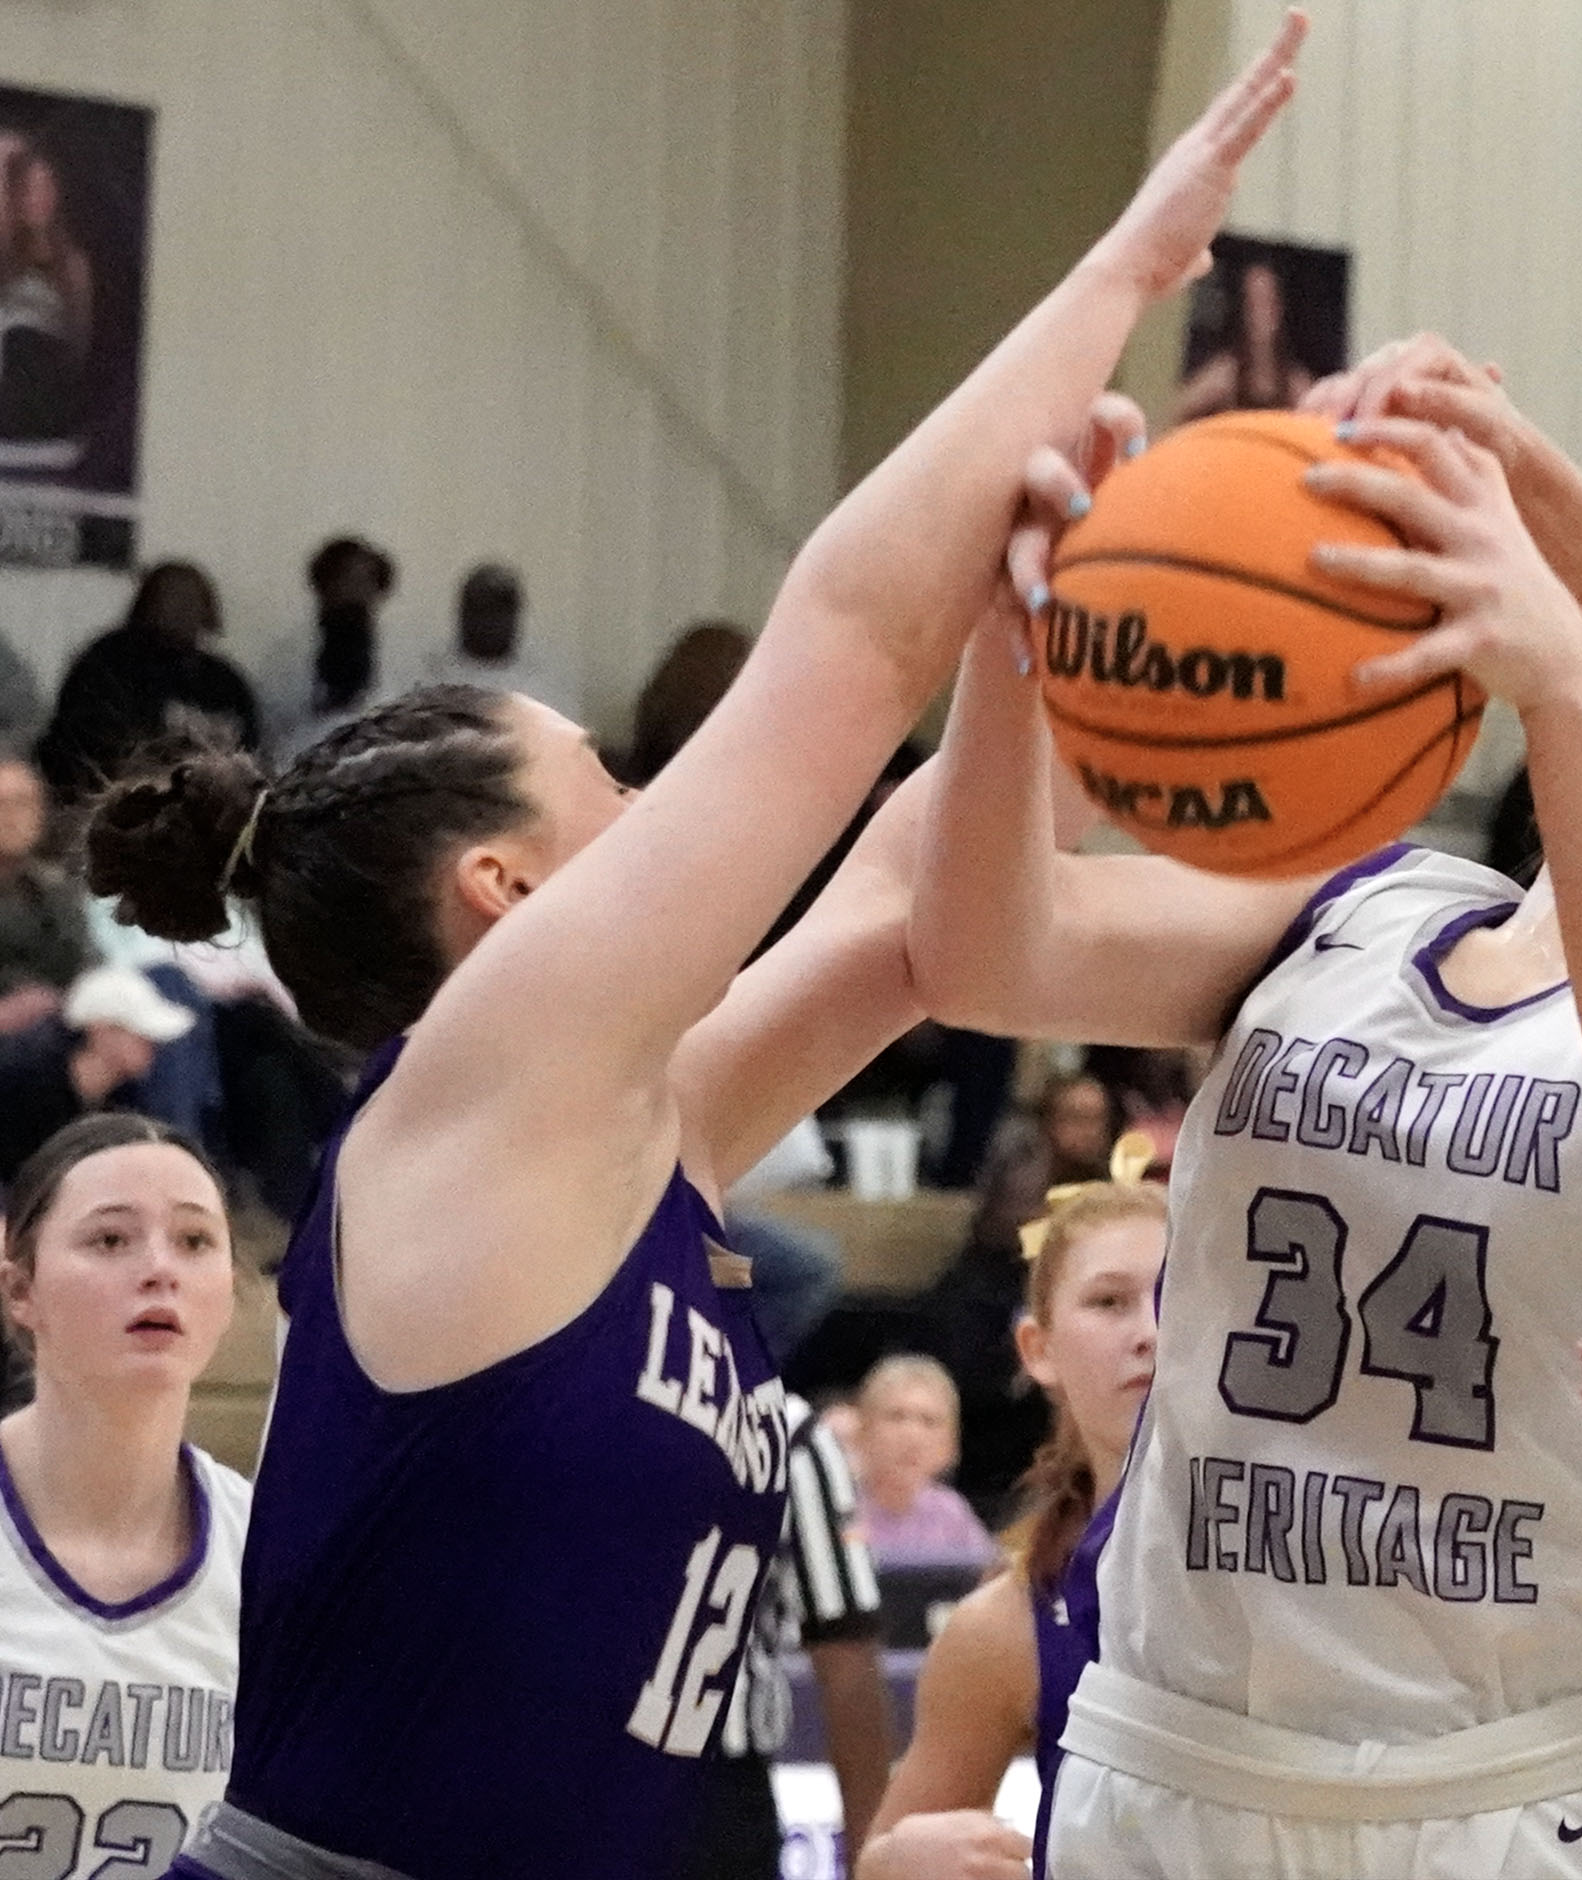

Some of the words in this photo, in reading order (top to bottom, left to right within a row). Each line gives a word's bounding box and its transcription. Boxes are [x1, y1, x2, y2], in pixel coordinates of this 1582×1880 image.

[1046, 603, 1286, 700] Wilson
[1214, 1027, 1582, 1193] DECATUR
[1217, 1186, 1499, 1452] 34
[0, 1672, 233, 1773] ECATUR
[626, 1525, 760, 1757] 12
